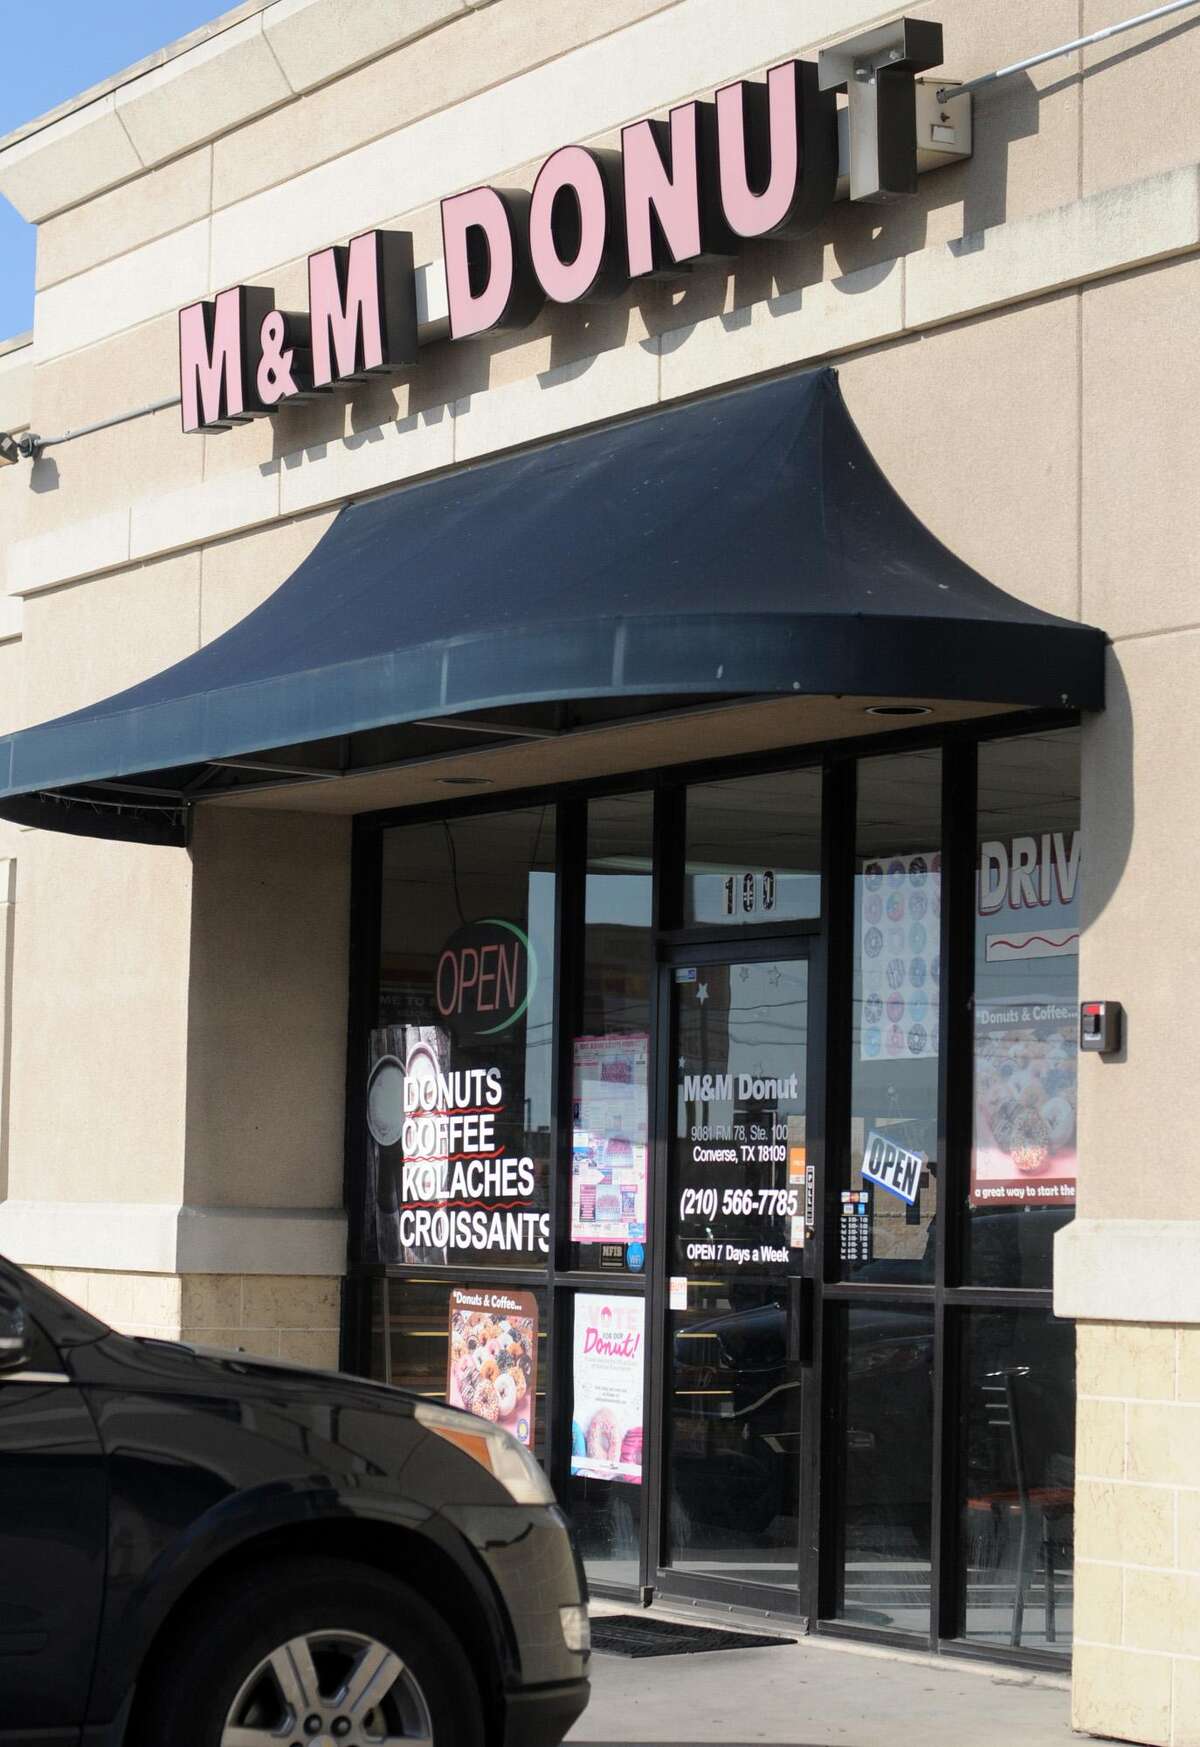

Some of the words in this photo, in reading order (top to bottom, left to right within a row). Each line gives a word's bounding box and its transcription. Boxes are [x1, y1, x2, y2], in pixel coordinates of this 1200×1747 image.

[179, 229, 390, 435] M&M
[978, 830, 1080, 916] DRIV
[725, 870, 774, 915] 100
[436, 942, 519, 1016] OPEN
[1022, 1007, 1031, 1021] &
[403, 1067, 502, 1113] DONUTS
[684, 1073, 733, 1101] M&M
[739, 1072, 798, 1100] Donut
[401, 1114, 495, 1157] COFFEE
[733, 1125, 748, 1142] 78,
[750, 1124, 768, 1141] Ste.
[772, 1124, 788, 1140] 100
[693, 1146, 738, 1164] Converse,
[740, 1145, 756, 1162] TX
[757, 1145, 786, 1162] 78109
[868, 1137, 918, 1197] OPEN
[401, 1157, 534, 1202] KOLACHES
[975, 1188, 981, 1198] a
[982, 1186, 1005, 1200] great
[1006, 1187, 1025, 1199] way
[1026, 1184, 1036, 1197] to
[1038, 1184, 1059, 1197] start
[1060, 1184, 1075, 1196] the
[680, 1188, 718, 1221] (210)
[722, 1188, 798, 1216] 566-7785
[400, 1210, 549, 1253] CROISSANTS
[687, 1243, 716, 1260] OPEN
[717, 1244, 723, 1260] 7
[725, 1245, 751, 1265] Days
[752, 1249, 759, 1262] a
[760, 1245, 789, 1263] Week
[483, 1294, 490, 1308] &
[584, 1327, 640, 1359] Donut!
